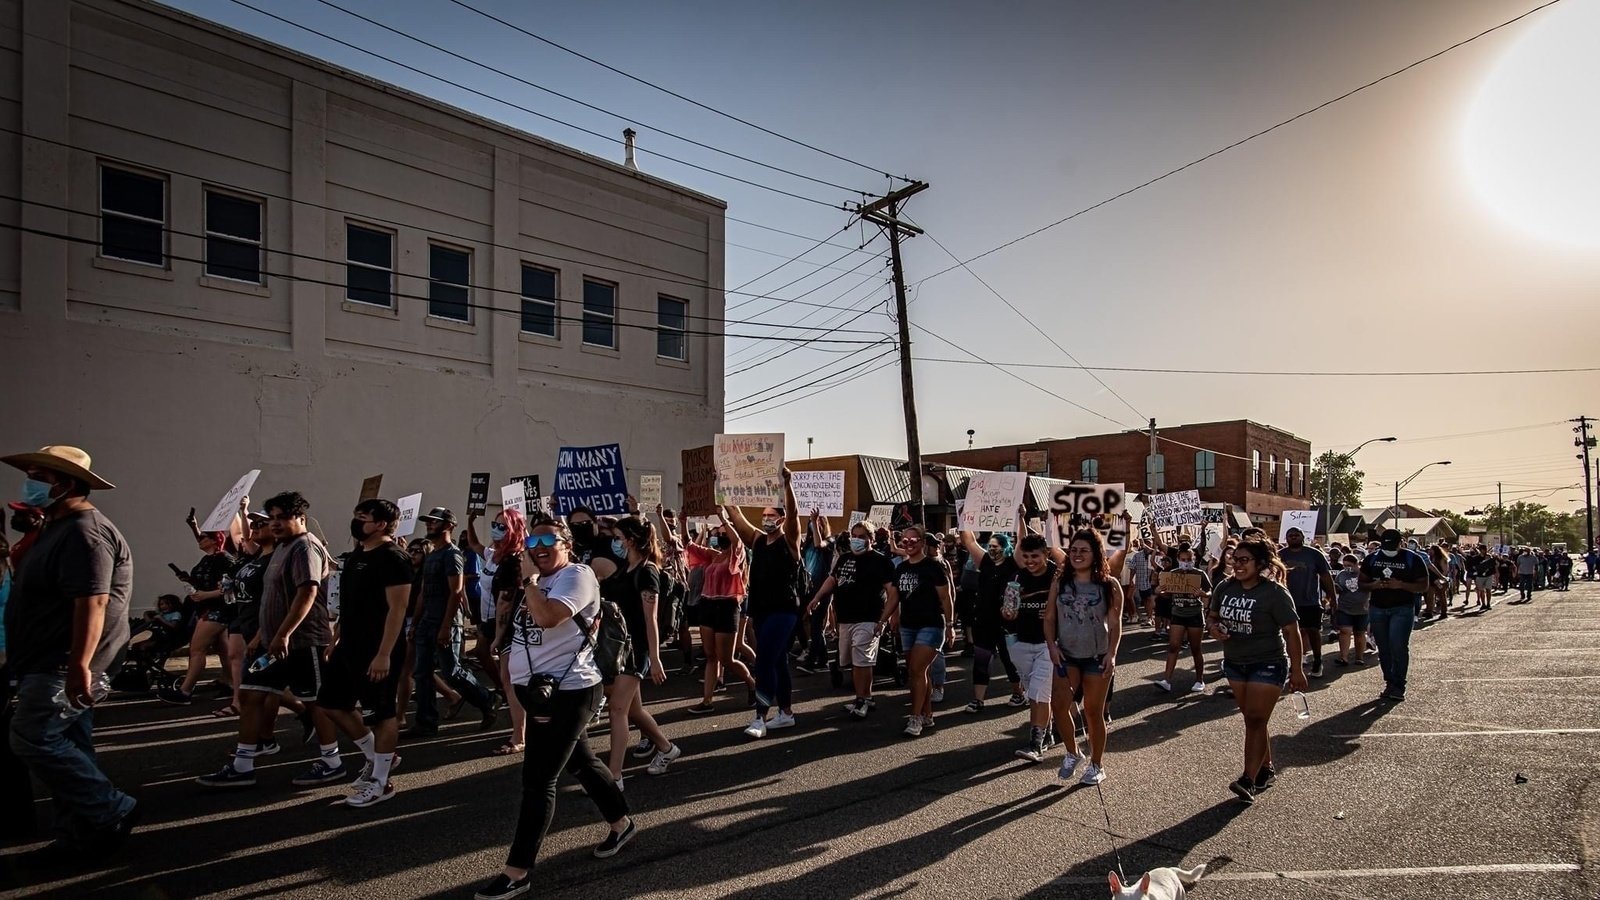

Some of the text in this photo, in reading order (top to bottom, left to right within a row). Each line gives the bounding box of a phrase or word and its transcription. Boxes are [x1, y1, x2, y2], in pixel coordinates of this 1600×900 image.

[558, 446, 618, 468] HOW MANY
[558, 468, 615, 490] WEREN'T
[793, 472, 841, 480] SORRY FOR THE
[793, 481, 841, 489] INCONVENIENCE
[1050, 485, 1121, 513] STOP
[1177, 491, 1190, 500] THE
[558, 493, 625, 512] FILMED?
[813, 501, 824, 509] THE
[826, 502, 843, 510] WORLD
[981, 505, 1000, 514] HATE
[979, 515, 1013, 527] PEACE
[1058, 524, 1126, 546] HE
[1221, 594, 1256, 609] I CAN'T
